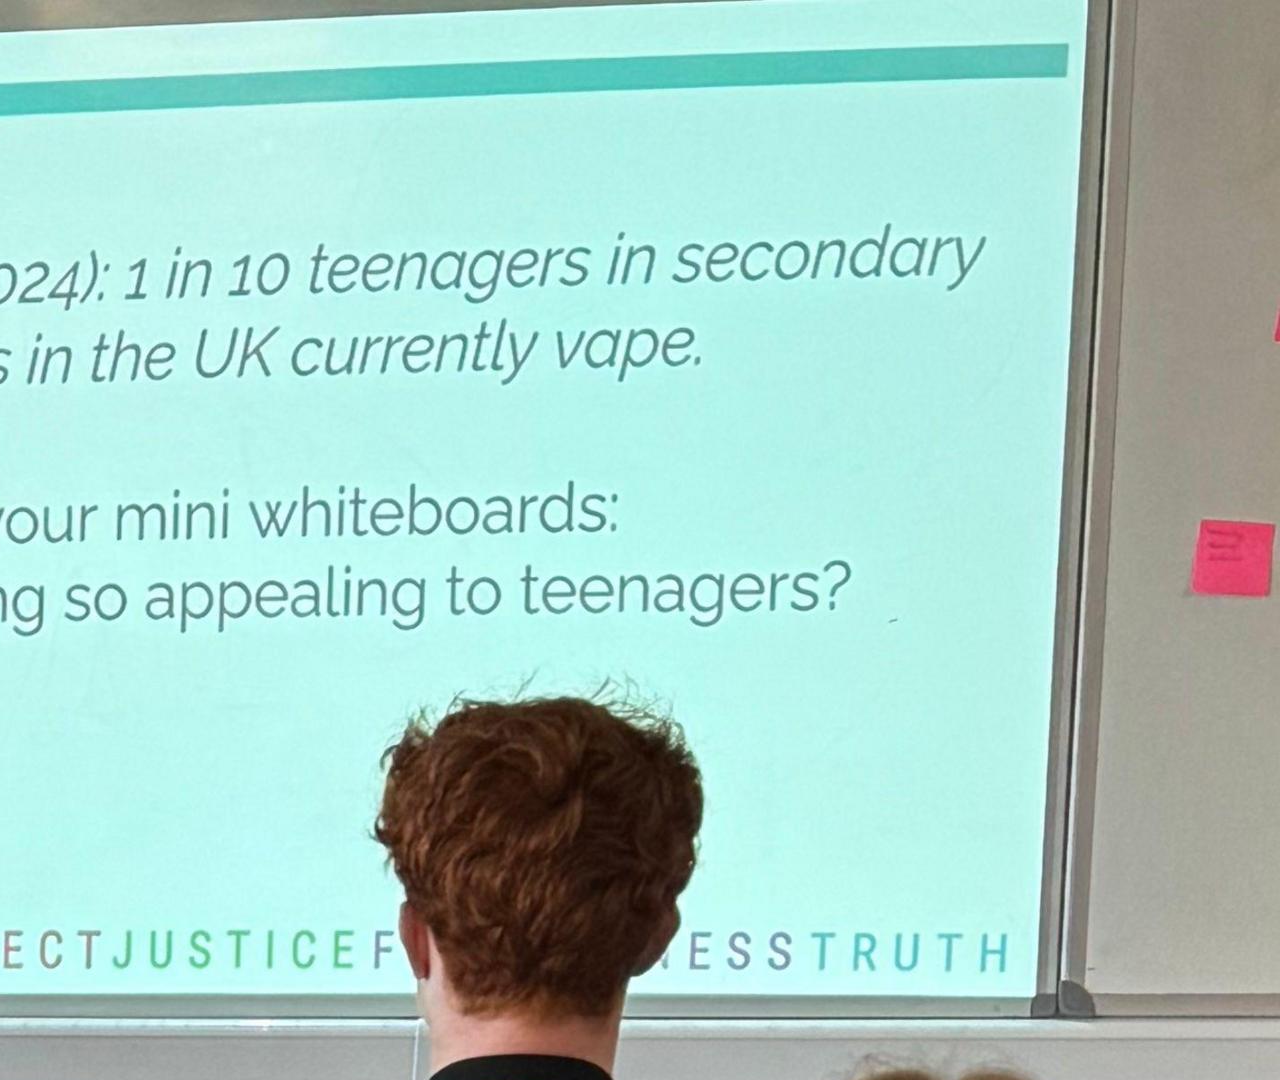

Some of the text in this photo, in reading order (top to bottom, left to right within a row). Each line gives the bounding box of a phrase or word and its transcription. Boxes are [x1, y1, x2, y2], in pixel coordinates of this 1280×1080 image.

[125, 258, 147, 300] 1
[166, 246, 212, 299] in
[228, 253, 290, 296] 10
[310, 243, 592, 304] teenagers
[607, 232, 655, 285] in
[672, 223, 986, 291] secondary
[27, 333, 72, 384] in
[91, 329, 176, 382] the
[196, 326, 280, 378] UK
[291, 318, 539, 386] currently
[556, 327, 701, 382] vape.
[117, 488, 229, 541] mini
[249, 480, 619, 538] whiteboards:
[64, 583, 127, 622] so
[145, 565, 426, 633] appealing
[446, 566, 501, 615] to
[520, 560, 852, 627] teenagers?
[111, 928, 355, 970] JUSTICE
[812, 931, 1008, 972] TRUTH
